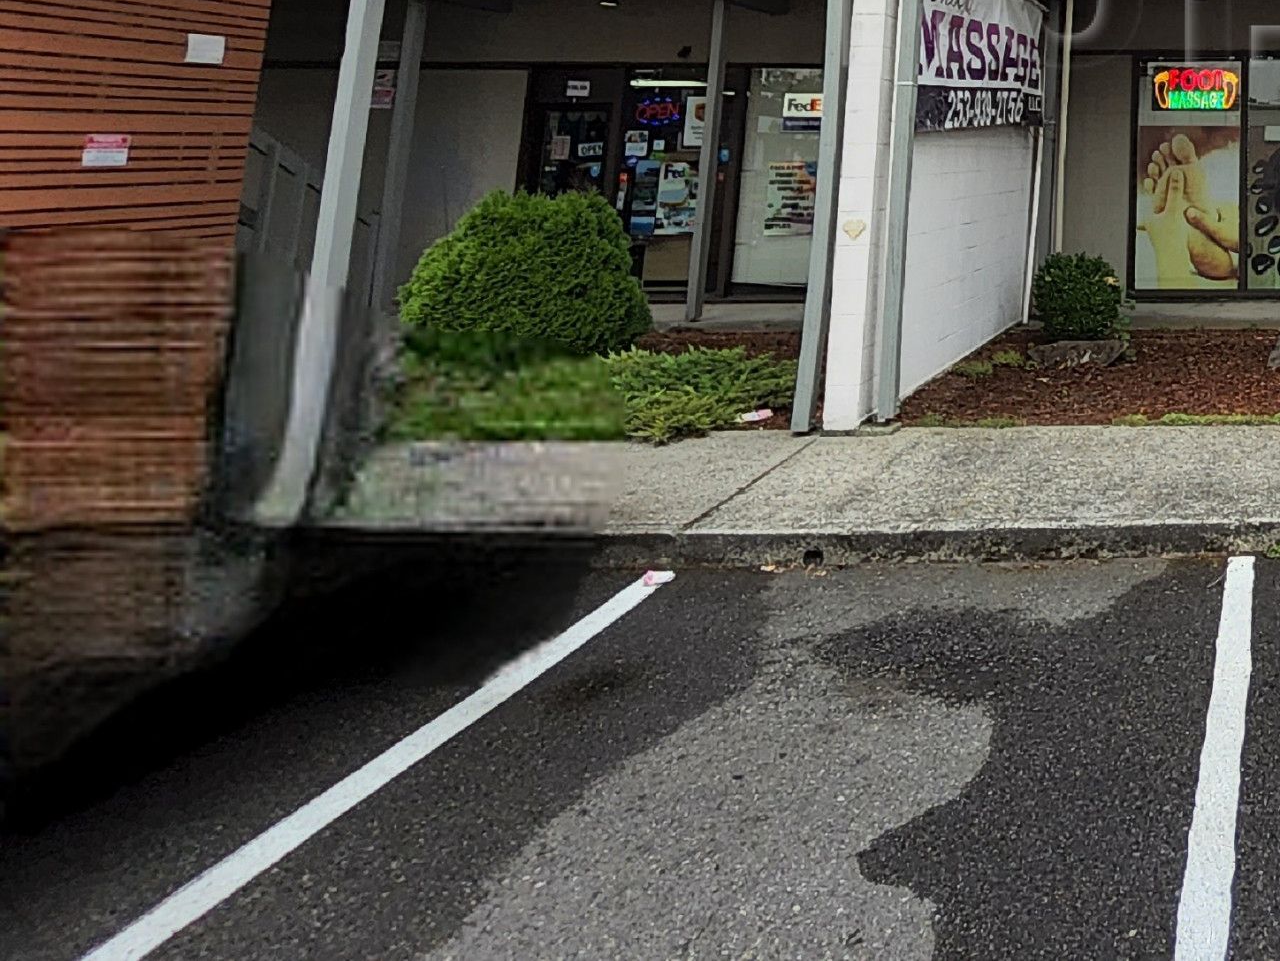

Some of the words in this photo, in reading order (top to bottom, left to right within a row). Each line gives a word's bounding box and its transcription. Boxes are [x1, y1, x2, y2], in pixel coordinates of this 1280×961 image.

[1168, 68, 1224, 92] FOOT
[788, 98, 822, 111] FedE
[944, 89, 1025, 129] 253-939-2756
[1168, 91, 1225, 110] MASSAGE
[635, 102, 681, 121] OPEN
[580, 143, 603, 156] OPEN
